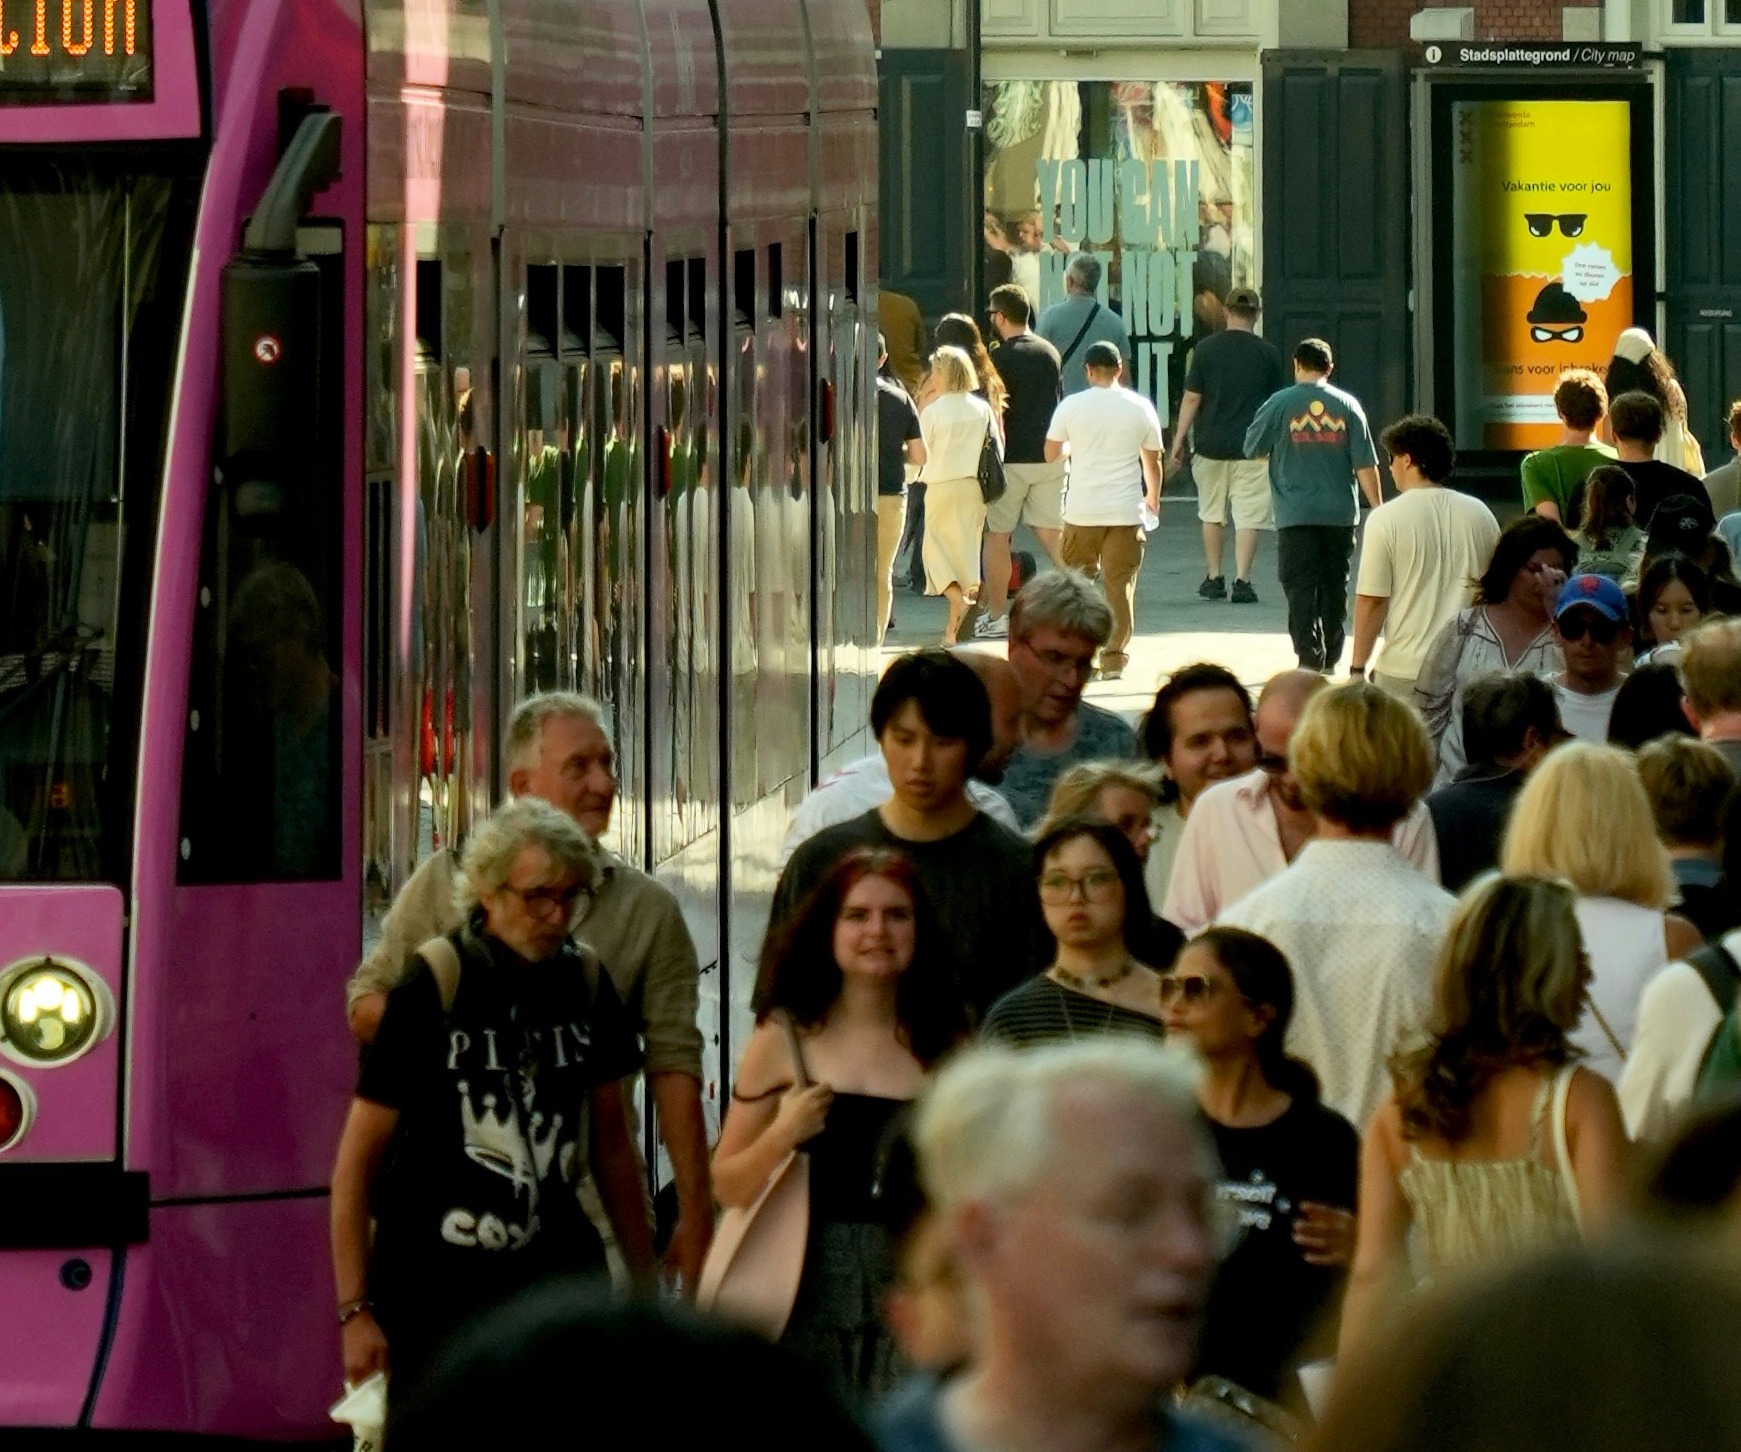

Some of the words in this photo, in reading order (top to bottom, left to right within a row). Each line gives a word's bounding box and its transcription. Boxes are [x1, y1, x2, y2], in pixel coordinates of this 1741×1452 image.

[1460, 48, 1571, 65] Stadsplattegrond
[1581, 48, 1605, 63] City
[1607, 51, 1636, 63] map
[1502, 180, 1556, 192] Vakantie
[1559, 183, 1587, 192] voor
[1590, 180, 1611, 194] jou
[1036, 158, 1114, 243] YOU
[1121, 158, 1199, 245] CAN
[1120, 250, 1198, 337] NOT
[1527, 365, 1555, 375] voor
